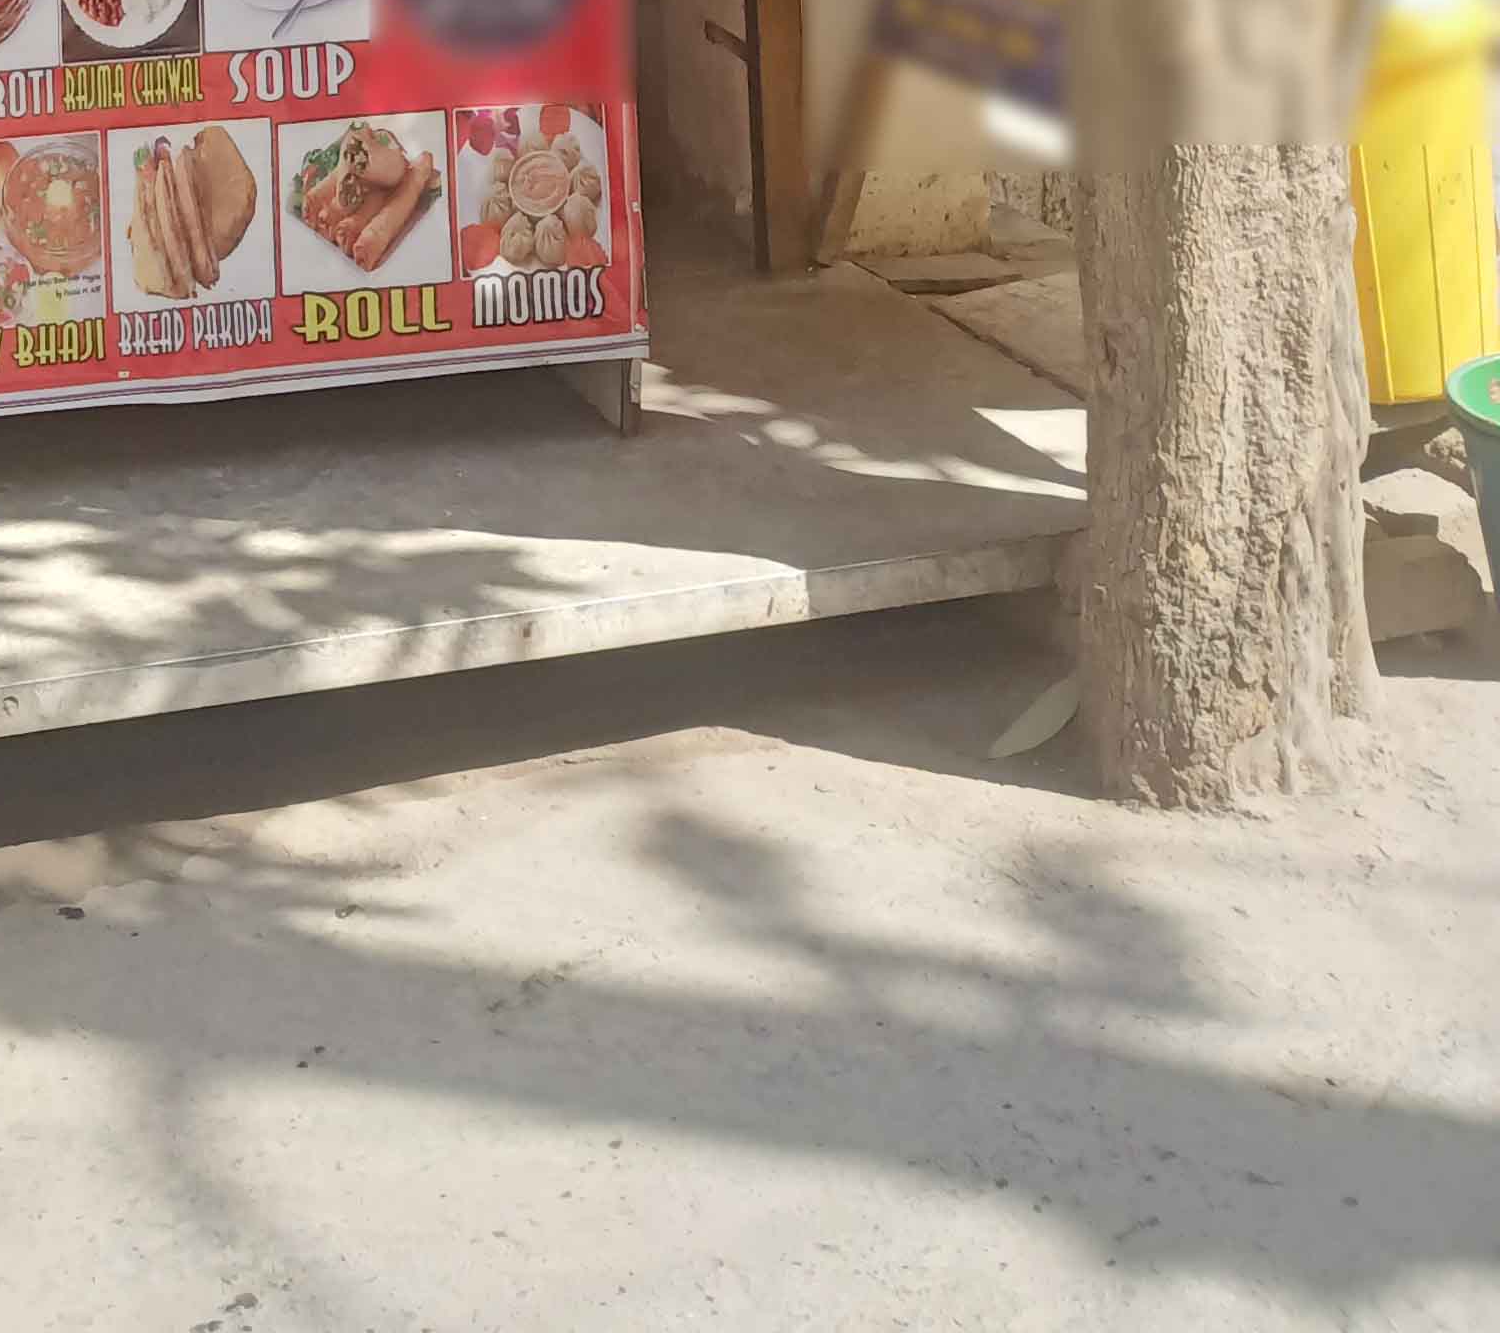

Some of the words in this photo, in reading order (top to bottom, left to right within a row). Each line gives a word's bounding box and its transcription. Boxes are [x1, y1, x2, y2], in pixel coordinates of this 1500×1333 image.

[62, 59, 125, 112] RAJMA
[131, 55, 204, 104] CHAWAL
[228, 43, 355, 104] SOUP
[293, 285, 452, 343] ROLL
[473, 267, 606, 327] MOMOS
[13, 316, 106, 368] BHAJI
[118, 308, 185, 357] BREAD
[192, 300, 273, 350] PAKODA
